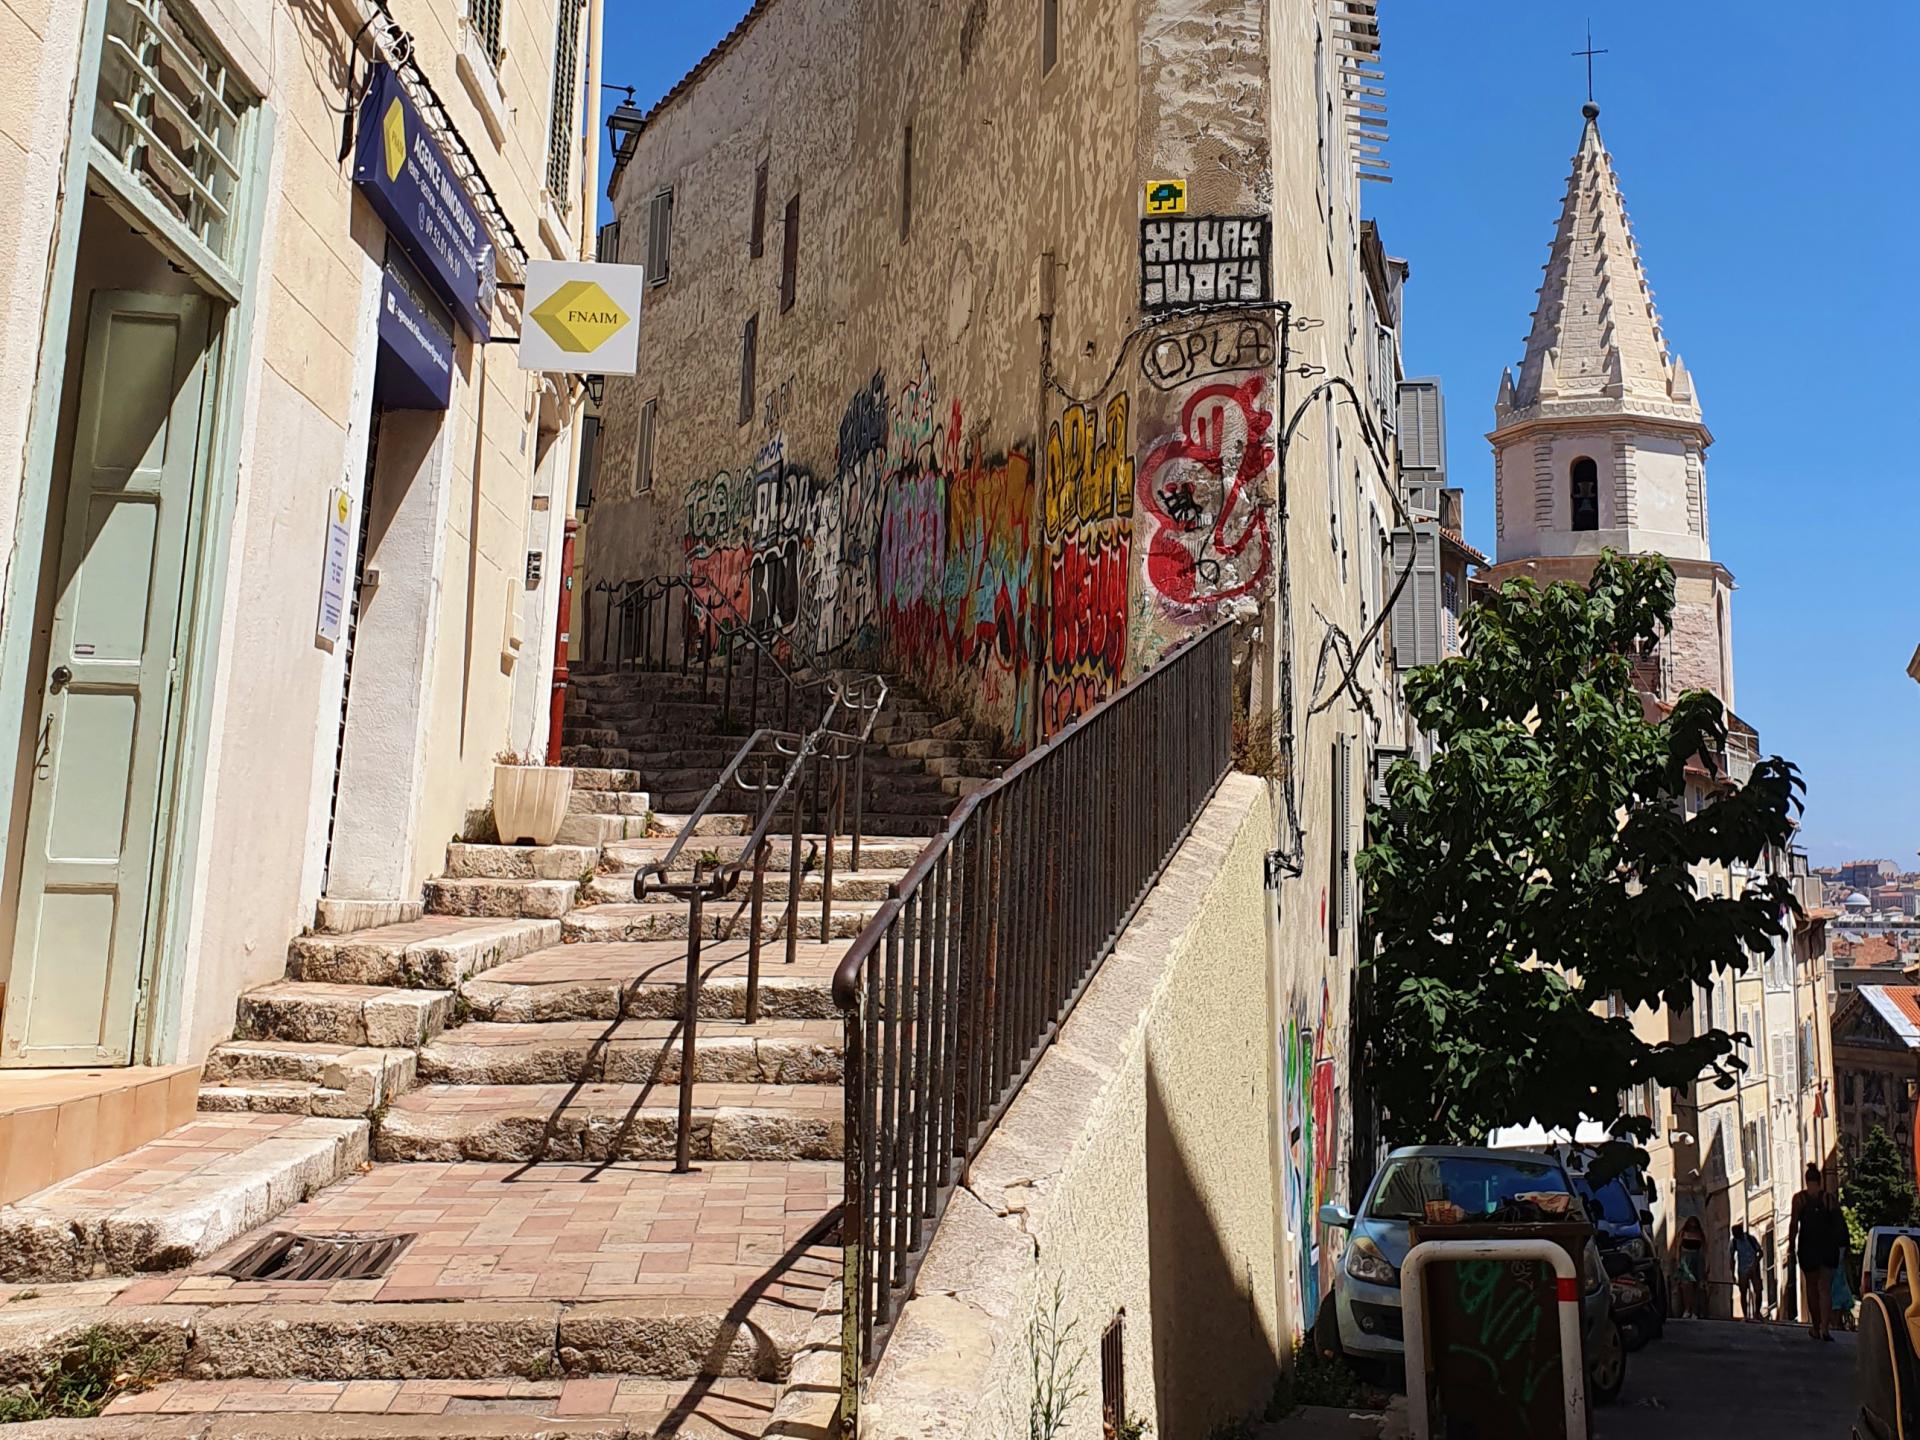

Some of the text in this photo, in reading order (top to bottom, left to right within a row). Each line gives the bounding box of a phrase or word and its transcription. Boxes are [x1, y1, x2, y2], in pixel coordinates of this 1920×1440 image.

[413, 132, 441, 191] AGENCE
[1145, 221, 1262, 262] XANAX
[567, 309, 619, 326] FNAIM
